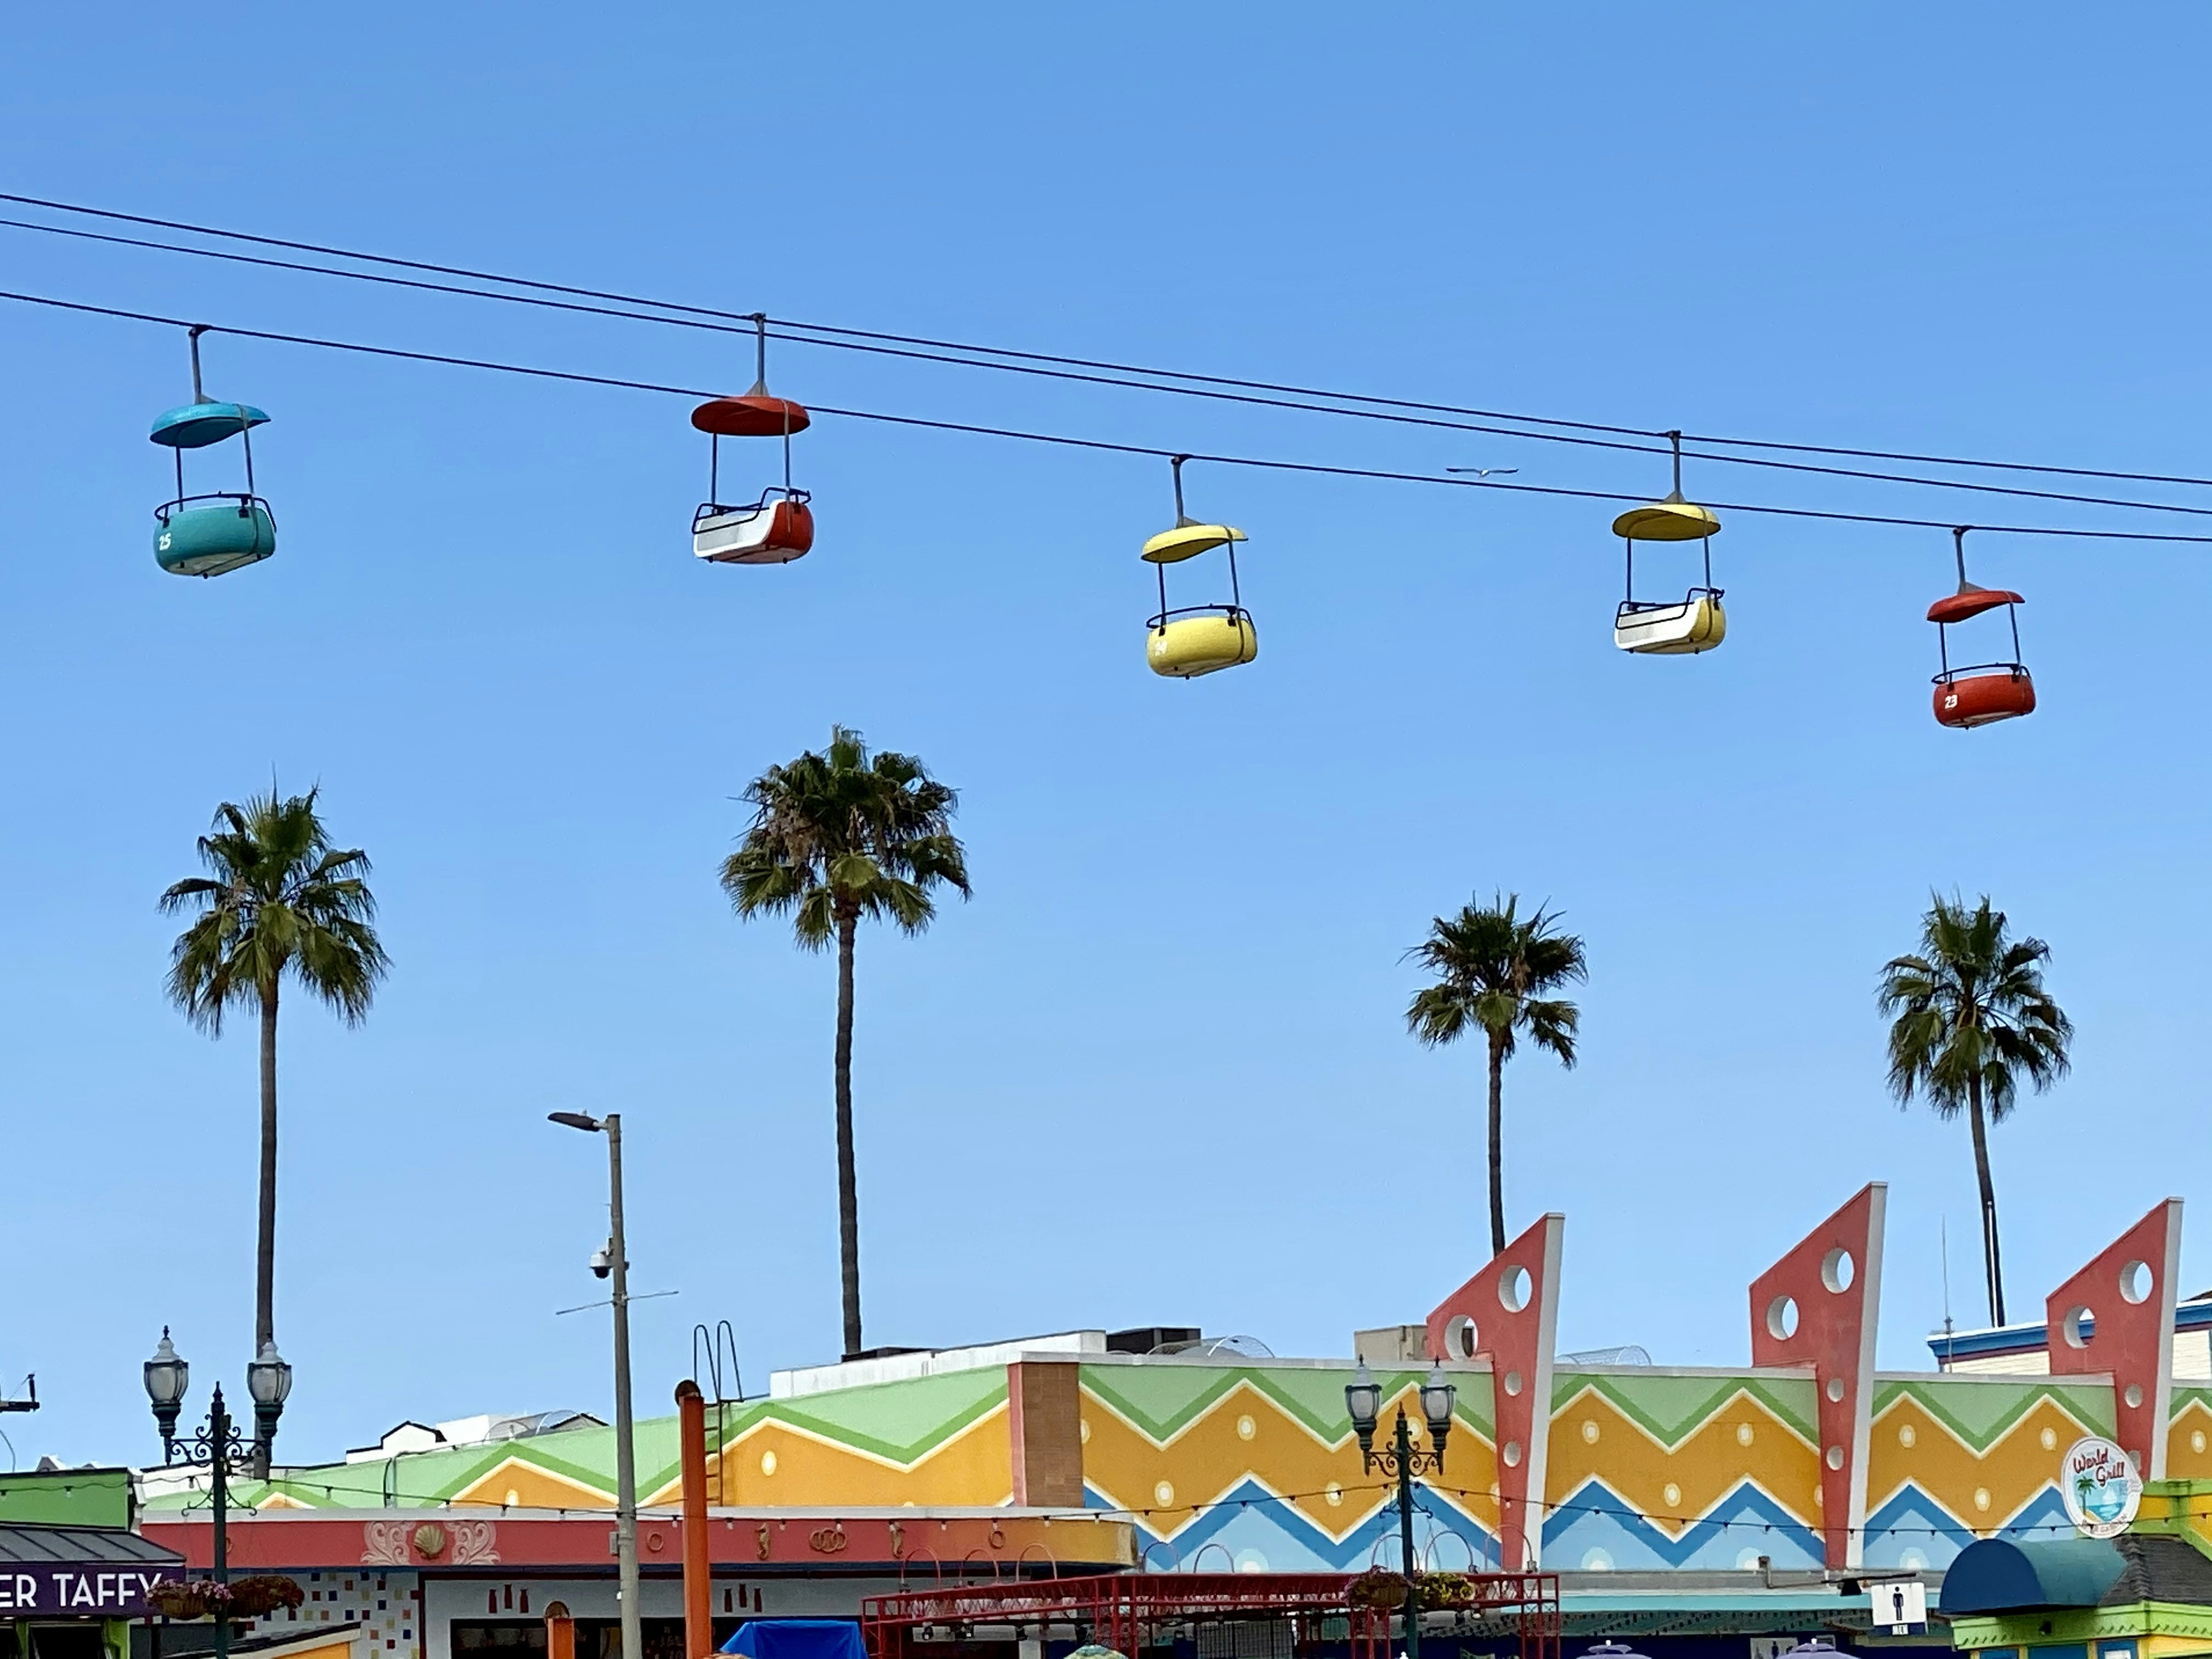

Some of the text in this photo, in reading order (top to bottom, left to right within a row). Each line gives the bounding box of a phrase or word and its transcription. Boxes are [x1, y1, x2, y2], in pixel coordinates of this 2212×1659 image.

[159, 532, 171, 551] 25
[1944, 694, 1958, 709] 23
[2073, 1447, 2109, 1474] World
[2096, 1461, 2124, 1487] Grill
[52, 1572, 163, 1607] TAFFY
